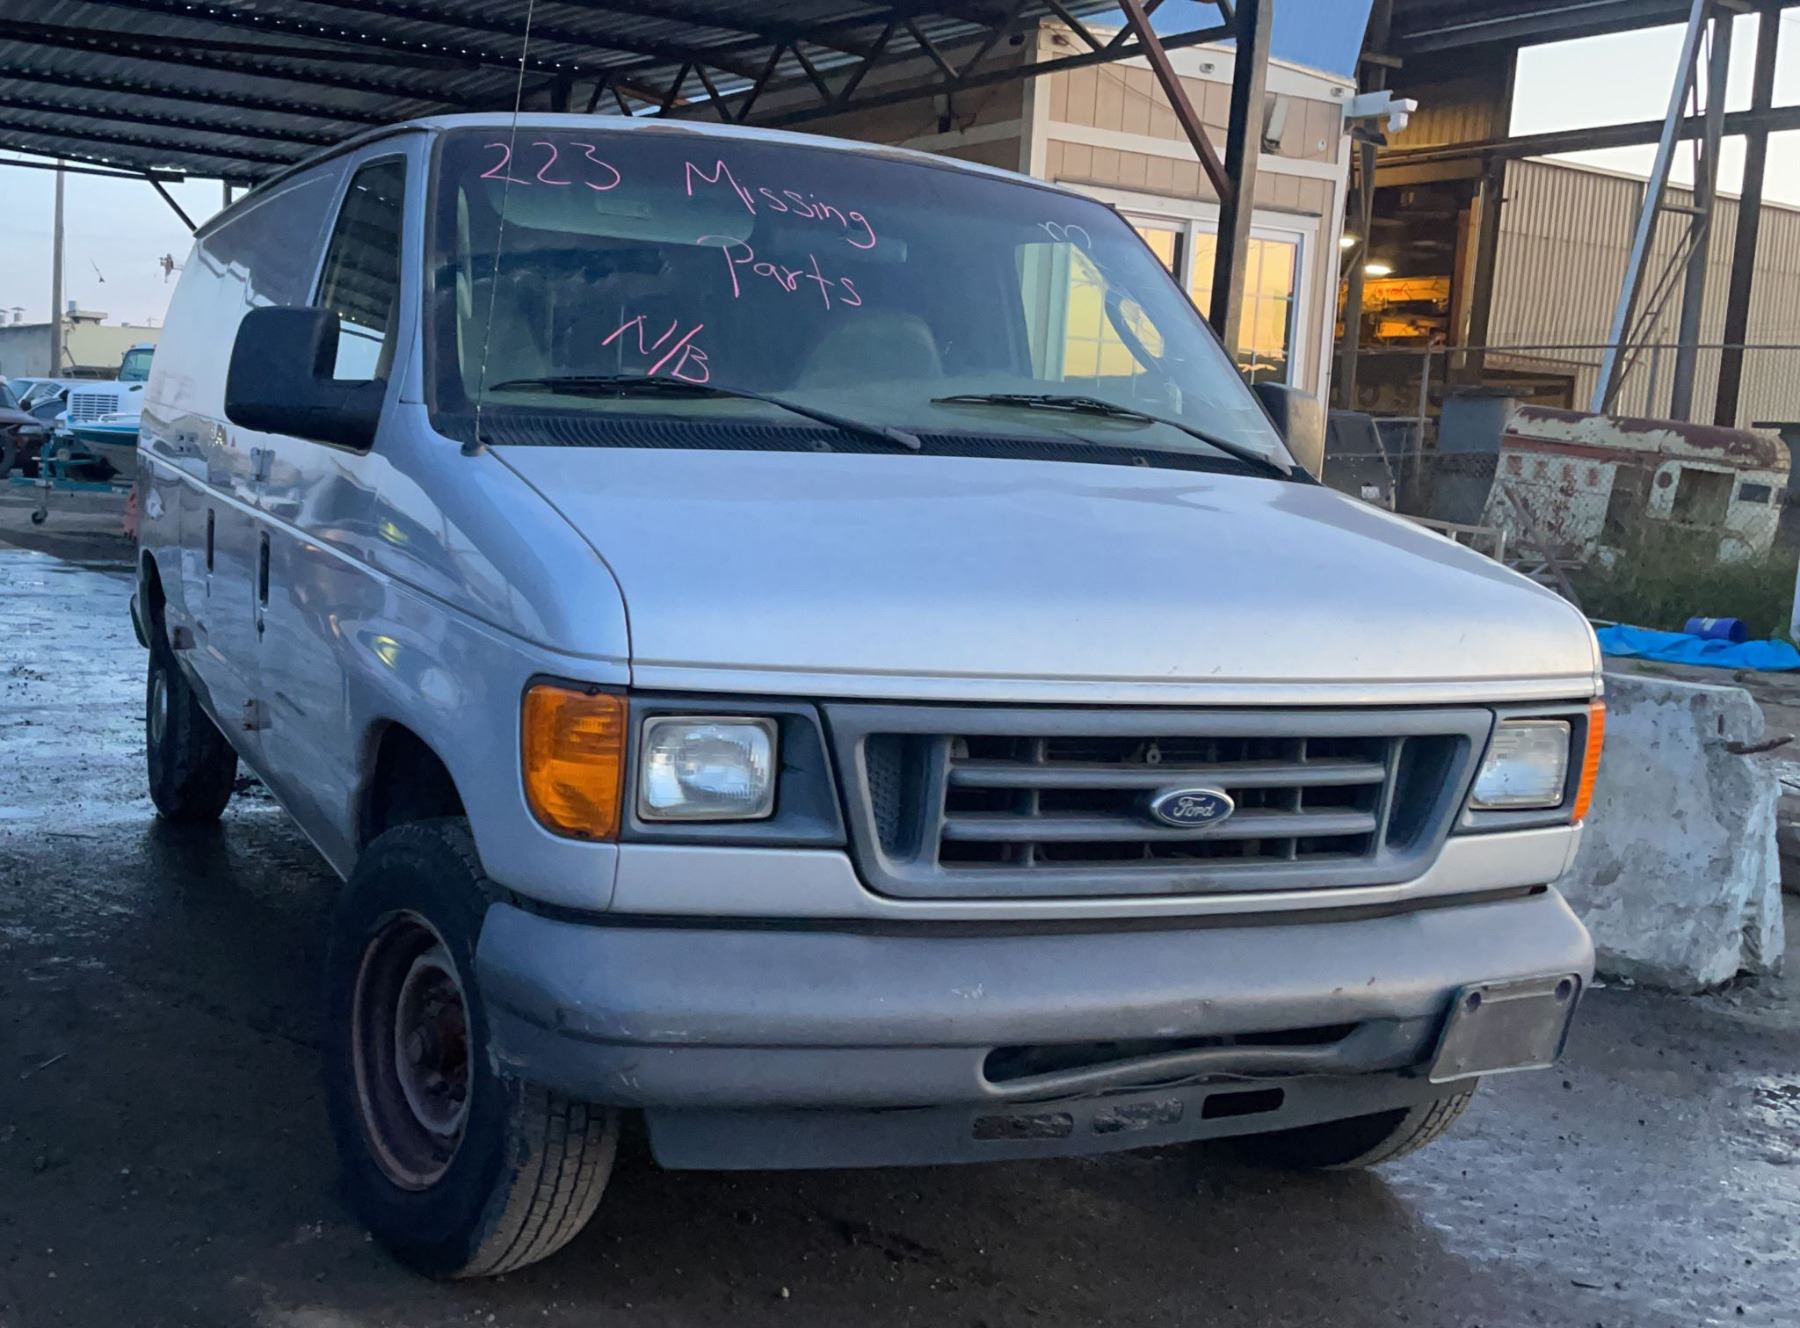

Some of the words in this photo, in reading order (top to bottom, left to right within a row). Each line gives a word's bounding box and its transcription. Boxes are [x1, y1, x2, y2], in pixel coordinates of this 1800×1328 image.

[480, 142, 621, 190] 223
[685, 159, 876, 249] Missing
[697, 235, 862, 310] Parts
[1173, 796, 1216, 817] Ford
